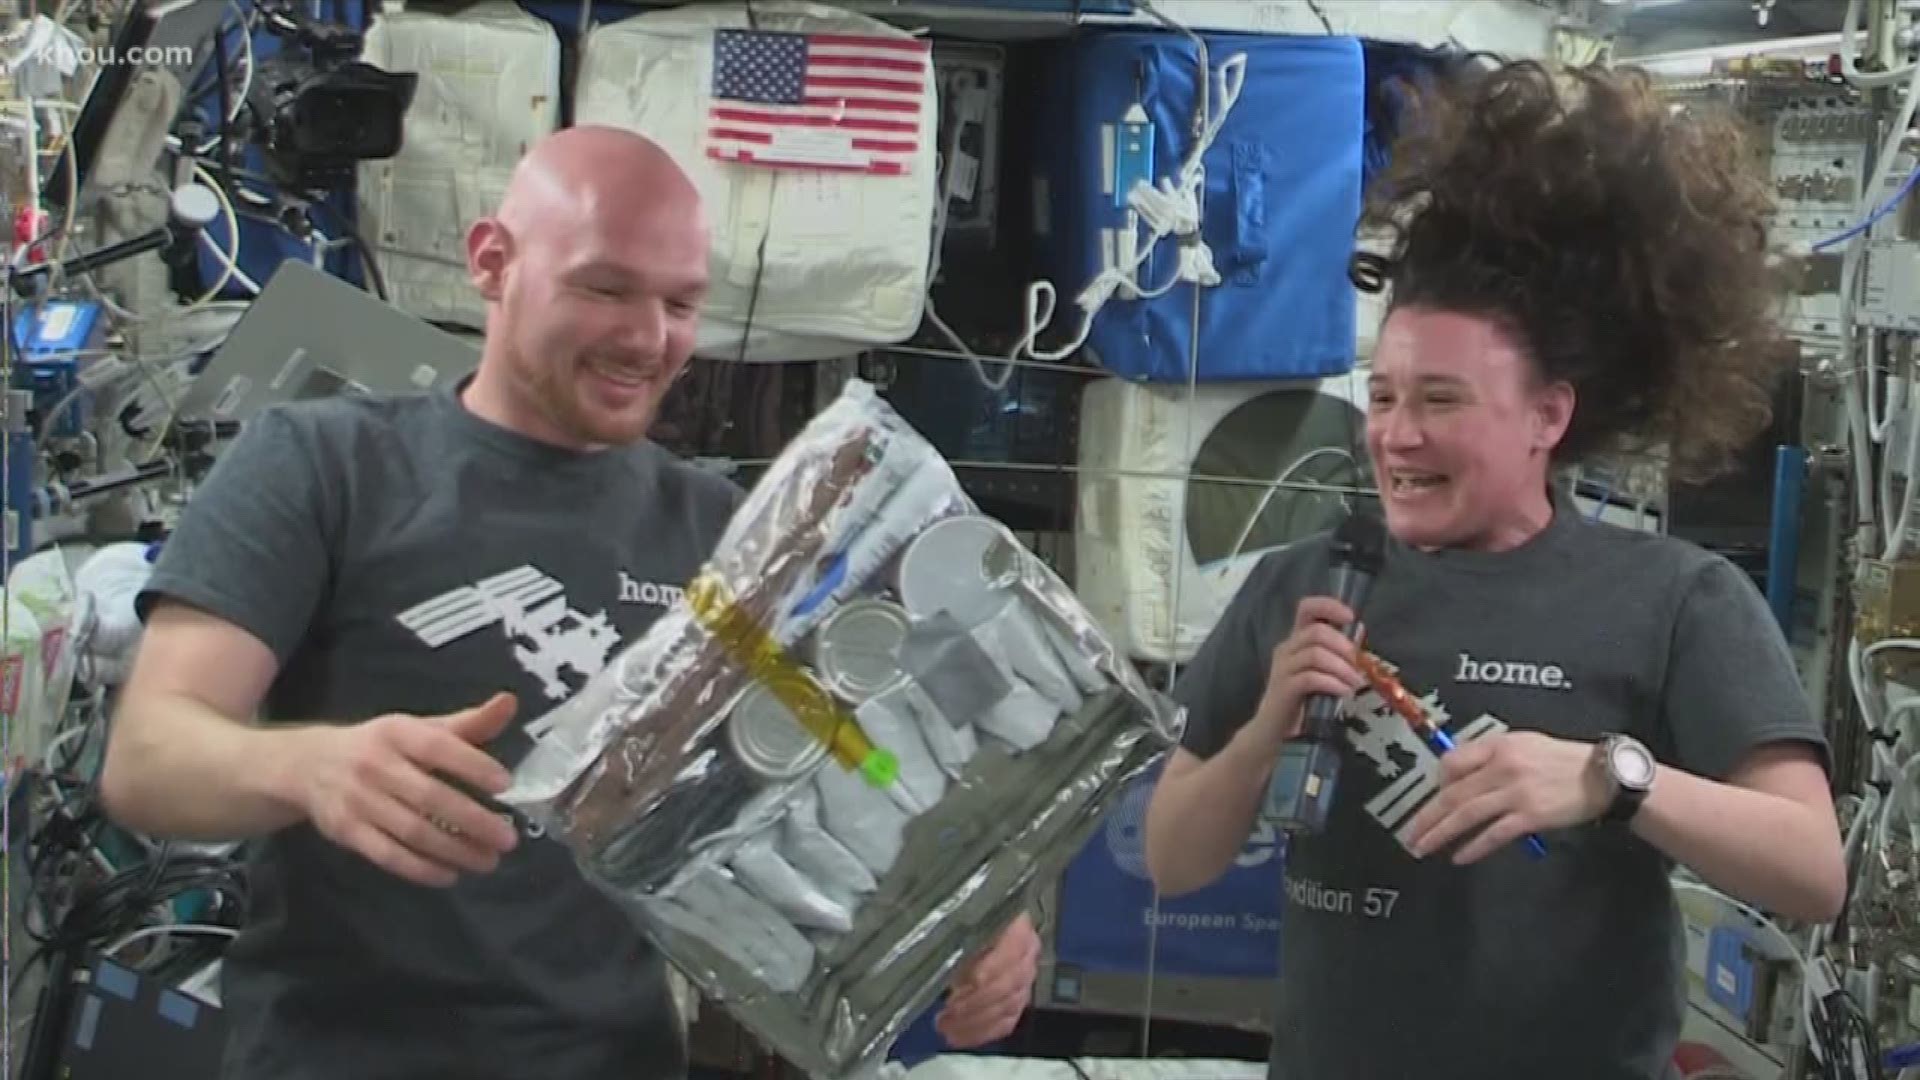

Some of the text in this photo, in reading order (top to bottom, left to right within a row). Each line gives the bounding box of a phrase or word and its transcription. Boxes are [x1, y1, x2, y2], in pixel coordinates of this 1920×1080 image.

[618, 571, 686, 606] hom
[1454, 653, 1573, 689] home.
[1363, 887, 1400, 919] 57
[1143, 908, 1281, 932] European Spa
